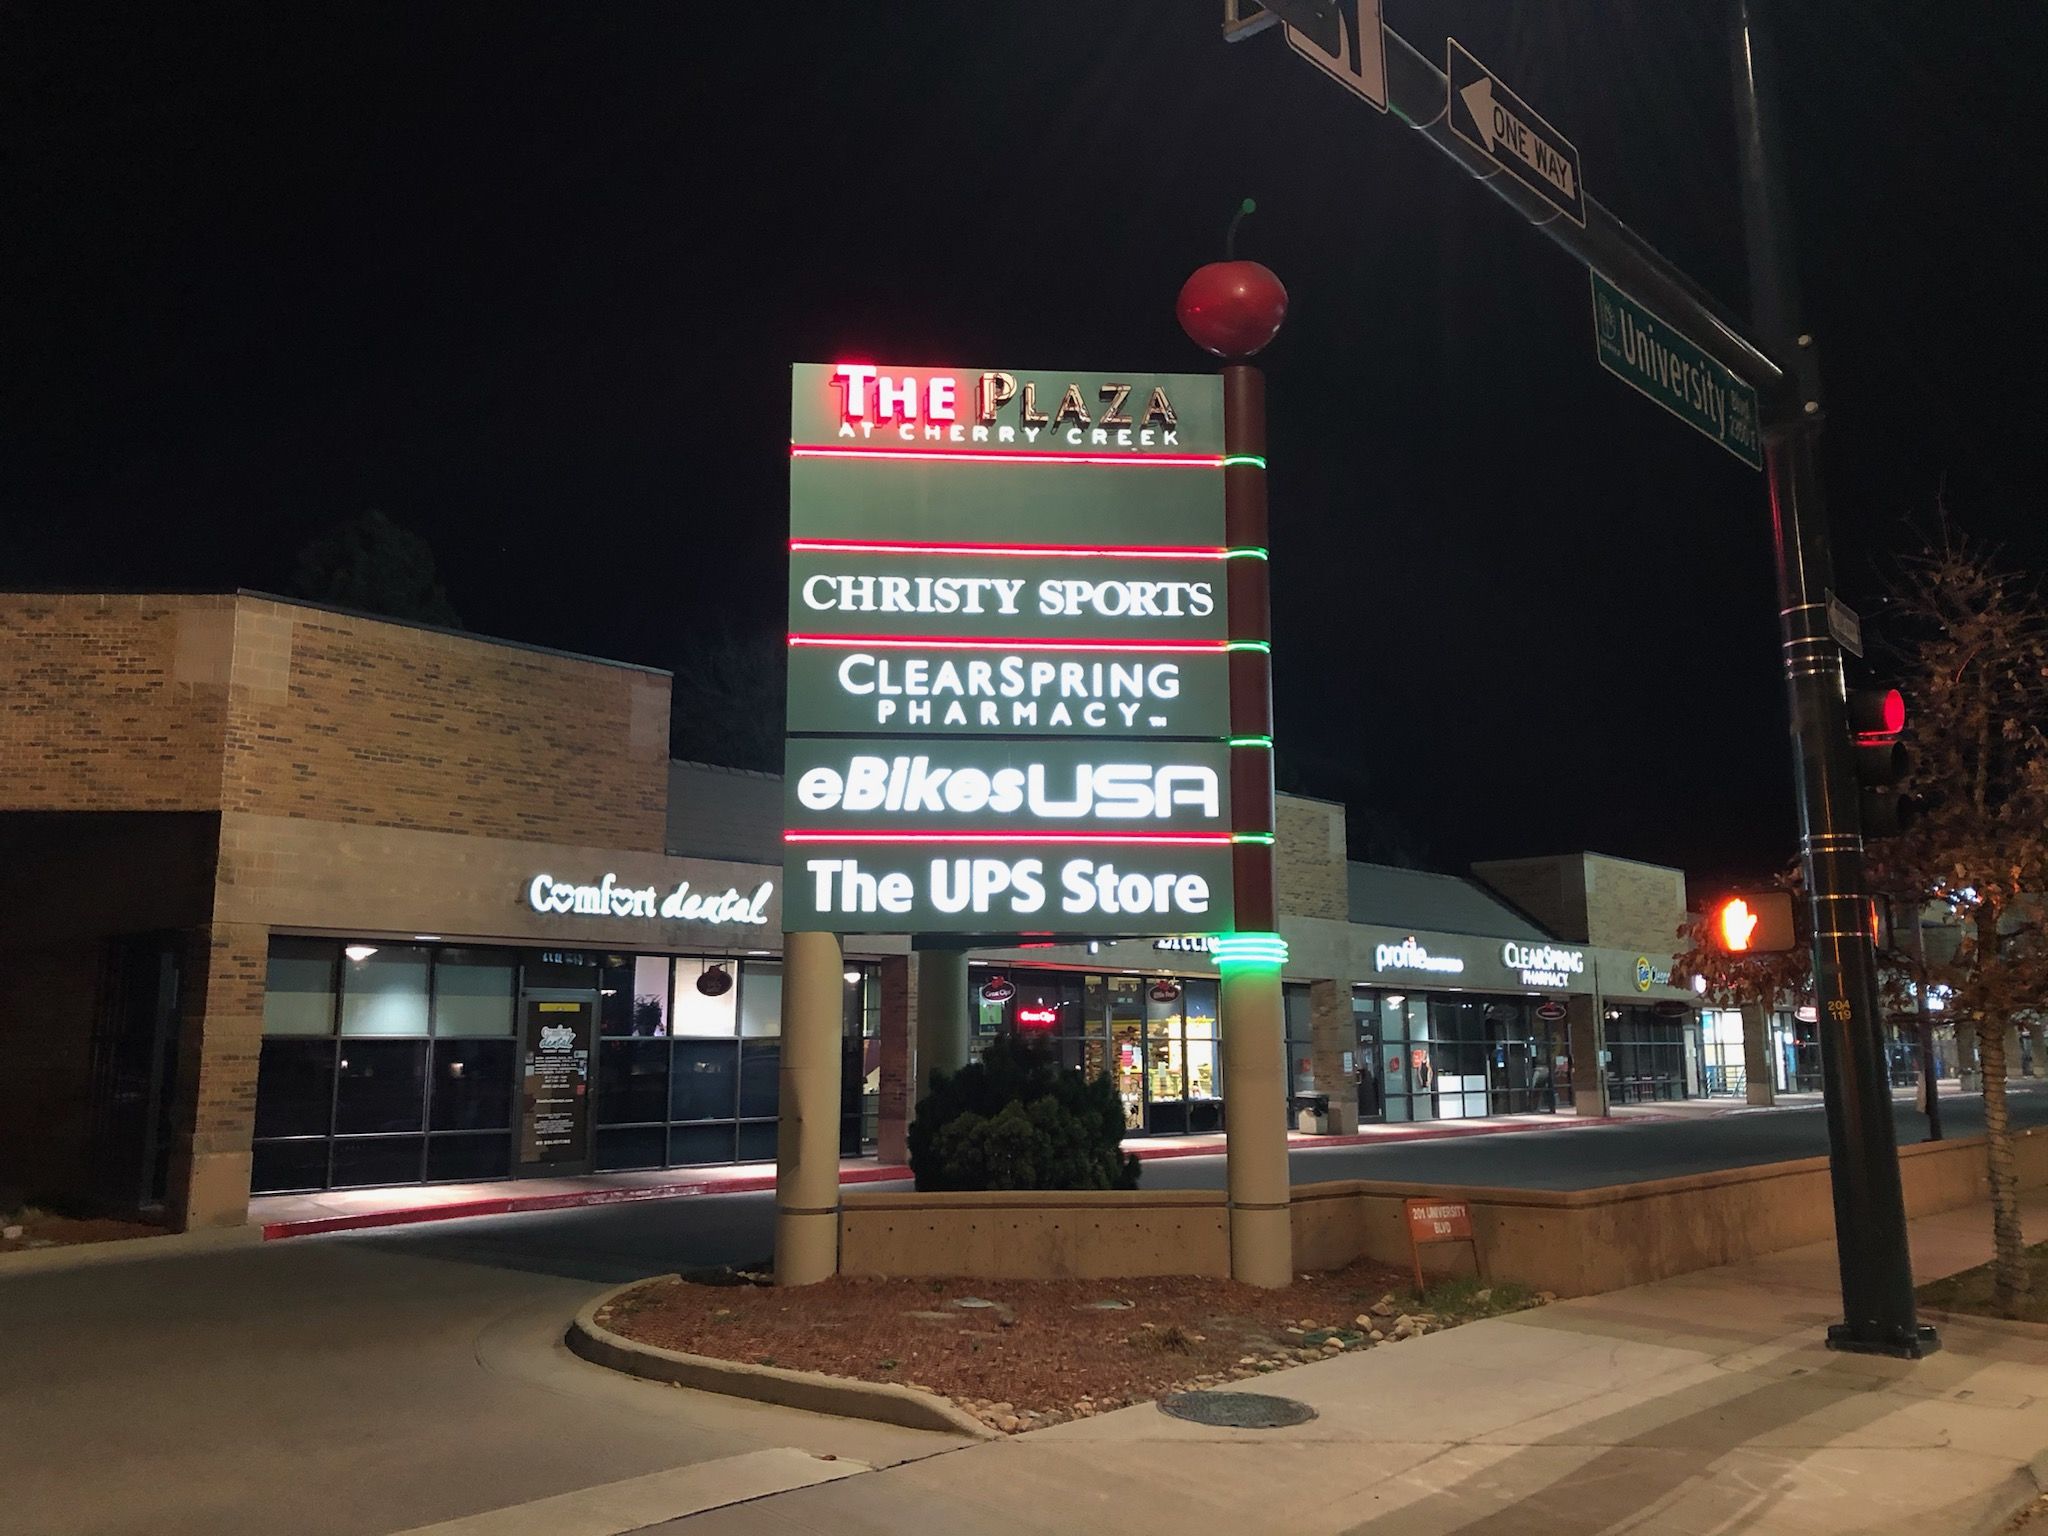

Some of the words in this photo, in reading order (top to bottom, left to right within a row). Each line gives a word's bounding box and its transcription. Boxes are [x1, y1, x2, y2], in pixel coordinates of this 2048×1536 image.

[1493, 105, 1529, 160] ONE
[1534, 138, 1567, 188] WAY
[835, 363, 957, 422] THE
[976, 371, 1179, 429] PLAZA
[1619, 308, 1726, 441] University
[838, 420, 876, 439] AT
[898, 422, 1041, 443] CHERRY
[1066, 427, 1180, 446] CREEK
[802, 574, 1026, 615] CHRISTY
[1038, 579, 1214, 617] SPORTS
[838, 653, 1181, 699] CLEARSPRING
[877, 699, 1141, 728] PHARMACY
[530, 872, 658, 918] Comfort
[660, 880, 774, 925] dental
[806, 859, 914, 913] The
[930, 858, 1046, 914] UPS
[1061, 858, 1210, 914] Store
[1831, 1010, 1852, 1021] 119
[1425, 1205, 1467, 1219] UNIVERSITY
